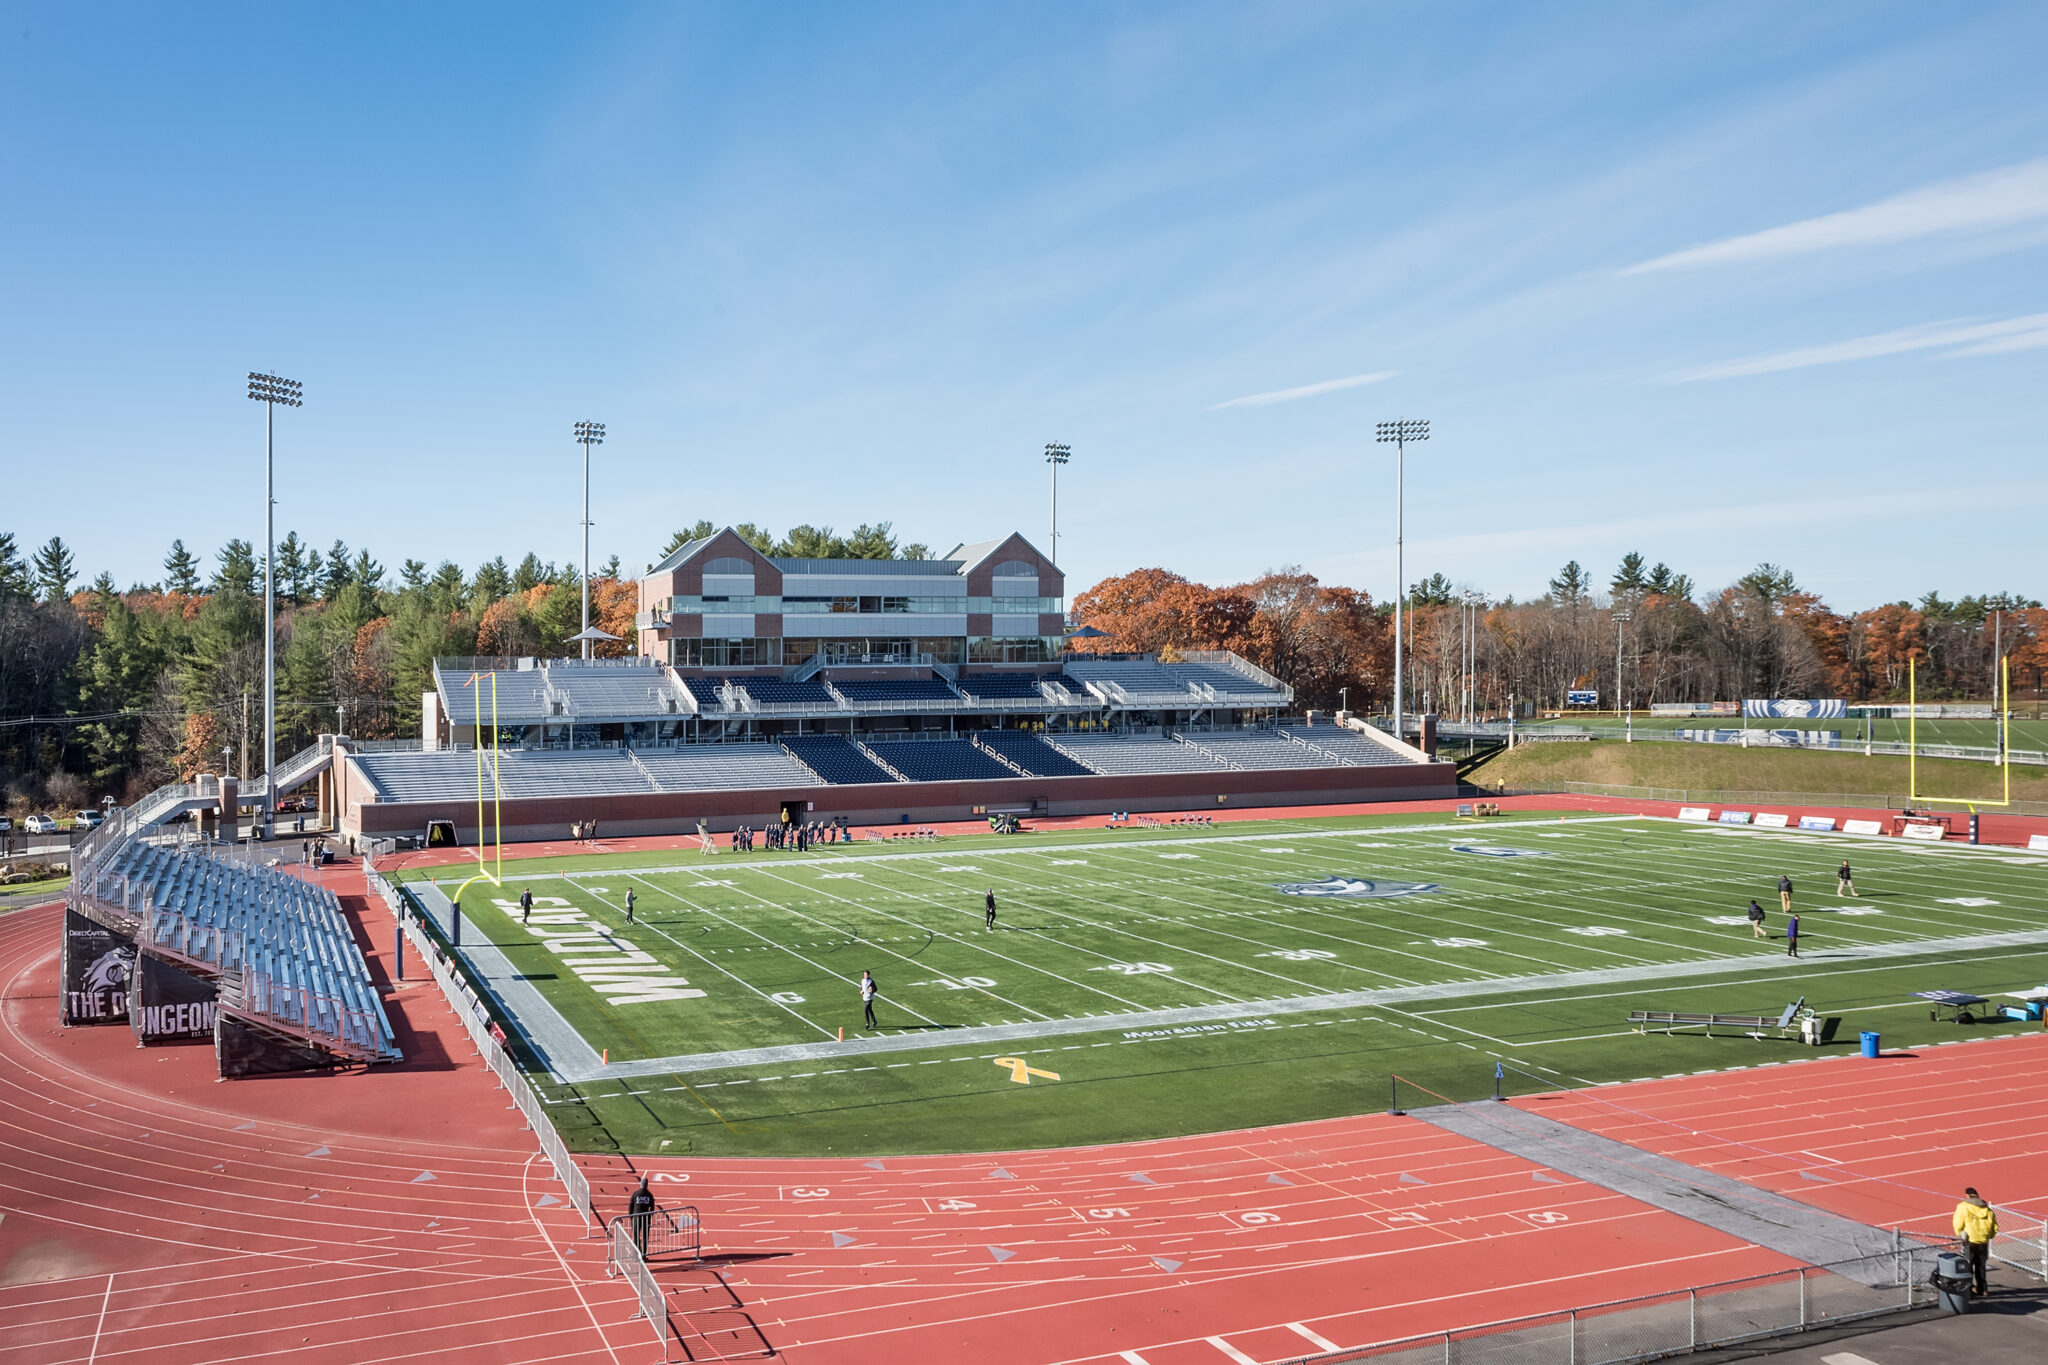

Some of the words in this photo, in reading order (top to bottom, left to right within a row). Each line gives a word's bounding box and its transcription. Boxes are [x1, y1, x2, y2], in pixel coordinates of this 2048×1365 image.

[1682, 828, 2048, 867] WILDCA
[1431, 937, 1489, 947] 40
[1270, 949, 1337, 960] 30
[1107, 962, 1174, 975] 20
[930, 976, 999, 990] 10
[770, 991, 807, 1004] G
[68, 991, 106, 1018] THE
[1121, 1024, 1228, 1039] Mooradian
[1226, 1018, 1277, 1029] Field
[651, 1173, 690, 1183] 2
[791, 1187, 830, 1198] 3
[938, 1199, 977, 1211] 4
[1088, 1207, 1132, 1219] 5
[1240, 1211, 1281, 1224] 6
[1387, 1211, 1430, 1222] 7
[1527, 1211, 1569, 1224] 8
